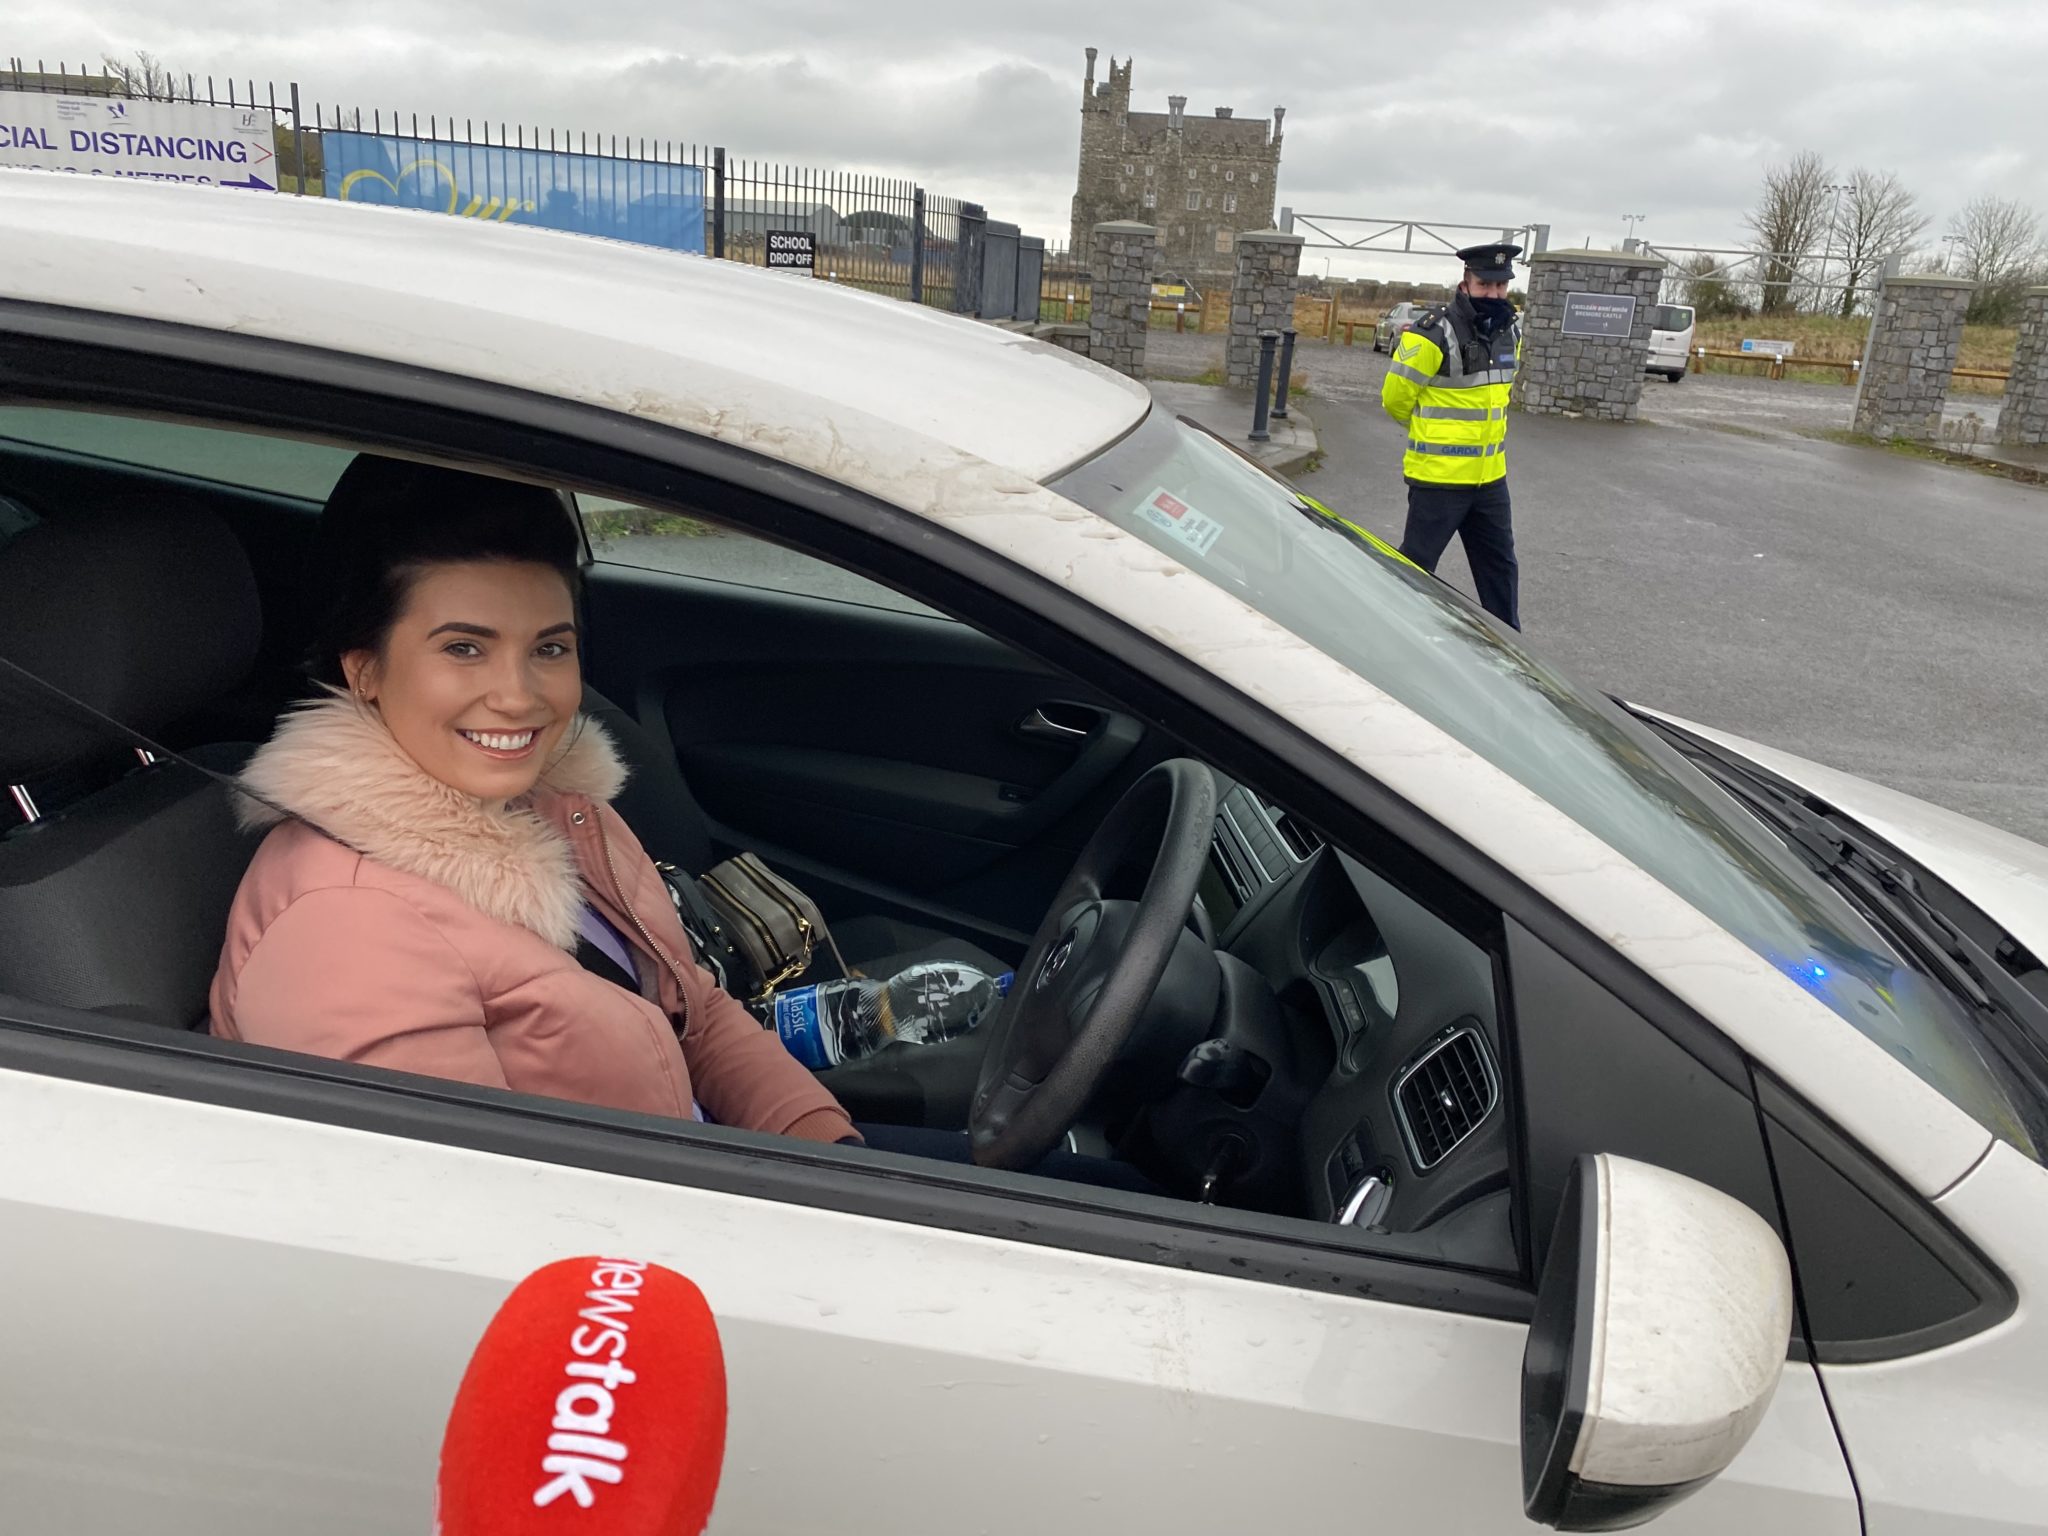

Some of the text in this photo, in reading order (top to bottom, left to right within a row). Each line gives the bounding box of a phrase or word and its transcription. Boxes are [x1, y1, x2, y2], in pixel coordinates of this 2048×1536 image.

[0, 124, 247, 163] CIAL DISTANCING
[770, 235, 812, 250] SCHOOL
[769, 252, 813, 265] DROP OFF
[1441, 446, 1479, 455] GARDA
[791, 995, 809, 1035] Classic
